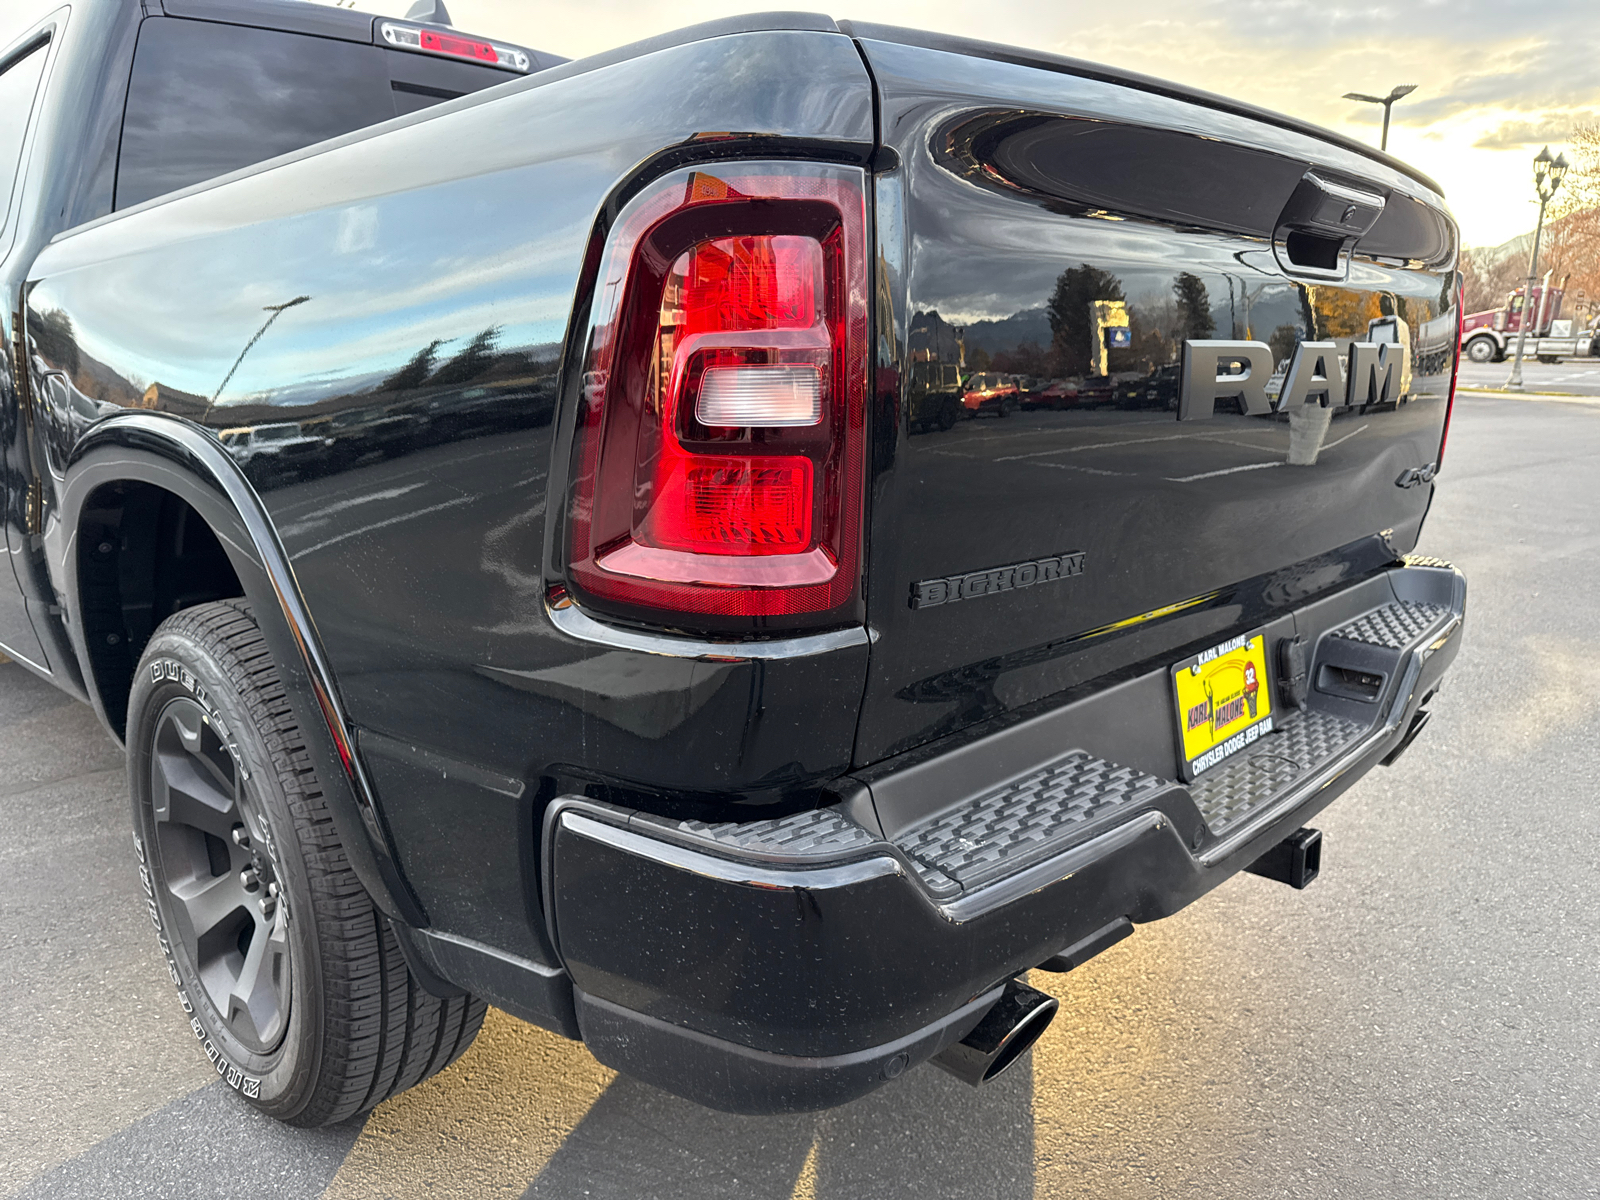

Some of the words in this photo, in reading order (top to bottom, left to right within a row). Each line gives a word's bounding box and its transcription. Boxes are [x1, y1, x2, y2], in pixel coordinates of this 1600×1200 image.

[1177, 339, 1404, 421] RAM
[908, 551, 1086, 610] BIGHORN
[1197, 647, 1218, 666] KARL
[1218, 634, 1246, 656] MALONE
[1245, 667, 1256, 685] 32
[1187, 699, 1209, 732] KARL
[1215, 695, 1245, 731] MALONE
[1192, 745, 1224, 777] CHRYSLER
[1224, 732, 1246, 757] DODGE
[1244, 724, 1259, 745] JEEP
[1259, 716, 1274, 737] RAM
